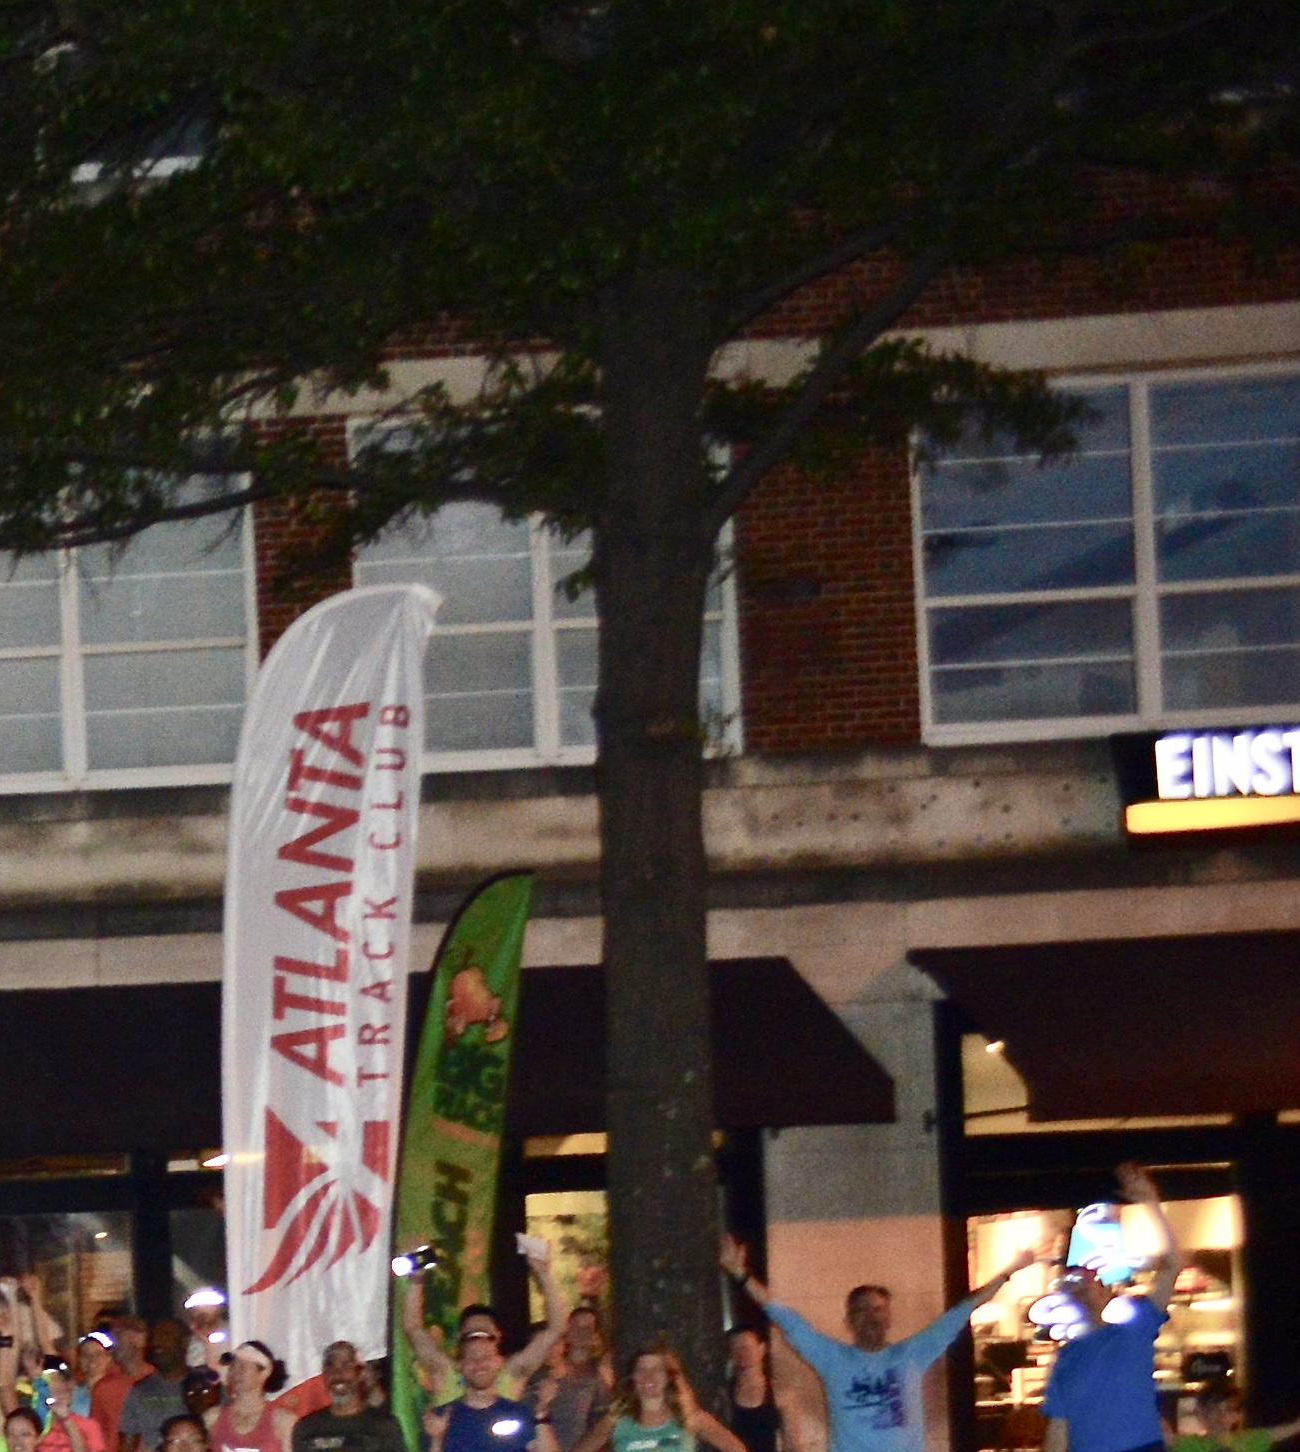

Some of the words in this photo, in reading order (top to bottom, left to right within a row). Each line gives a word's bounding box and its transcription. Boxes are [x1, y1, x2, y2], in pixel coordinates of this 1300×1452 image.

[369, 705, 410, 851] CLUB
[270, 702, 371, 1088] ATLANTA
[356, 895, 398, 1088] TRACK
